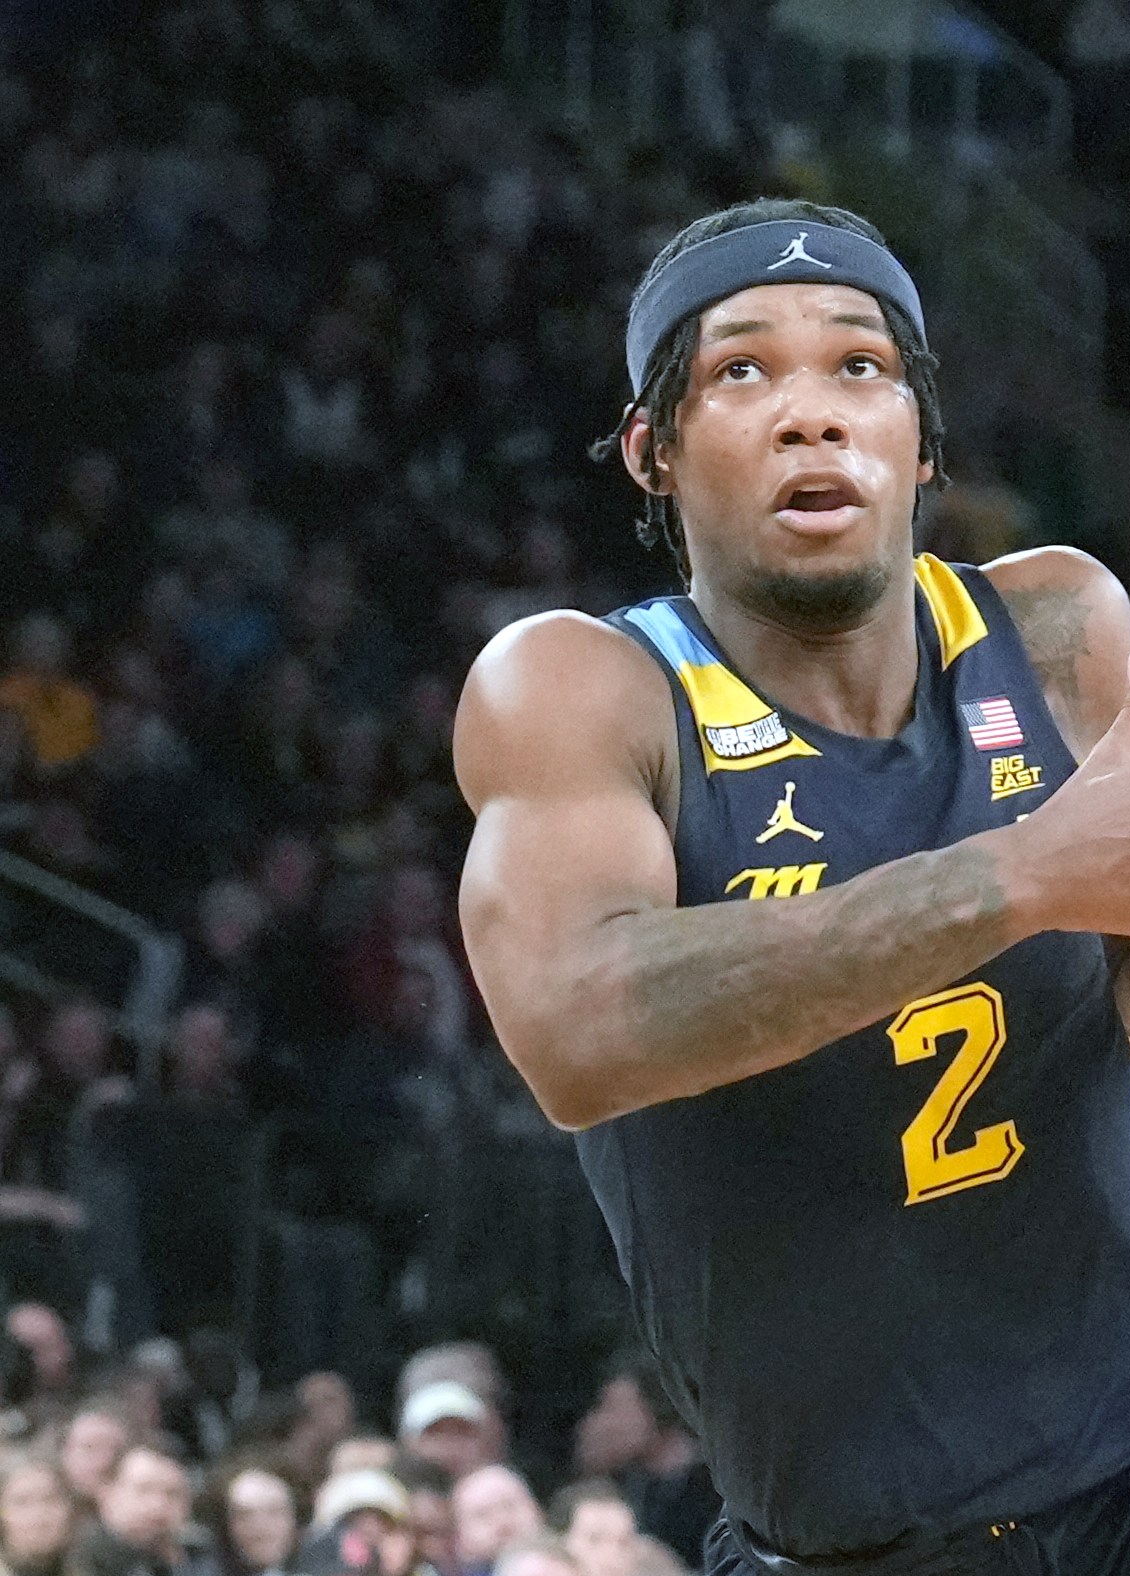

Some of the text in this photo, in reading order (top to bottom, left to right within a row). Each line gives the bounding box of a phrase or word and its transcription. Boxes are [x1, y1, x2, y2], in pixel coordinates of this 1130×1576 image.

[713, 728, 787, 756] CHANGE
[719, 725, 756, 745] BE
[991, 754, 1024, 775] BIG
[991, 766, 1042, 791] EAST
[886, 981, 1025, 1206] 2
